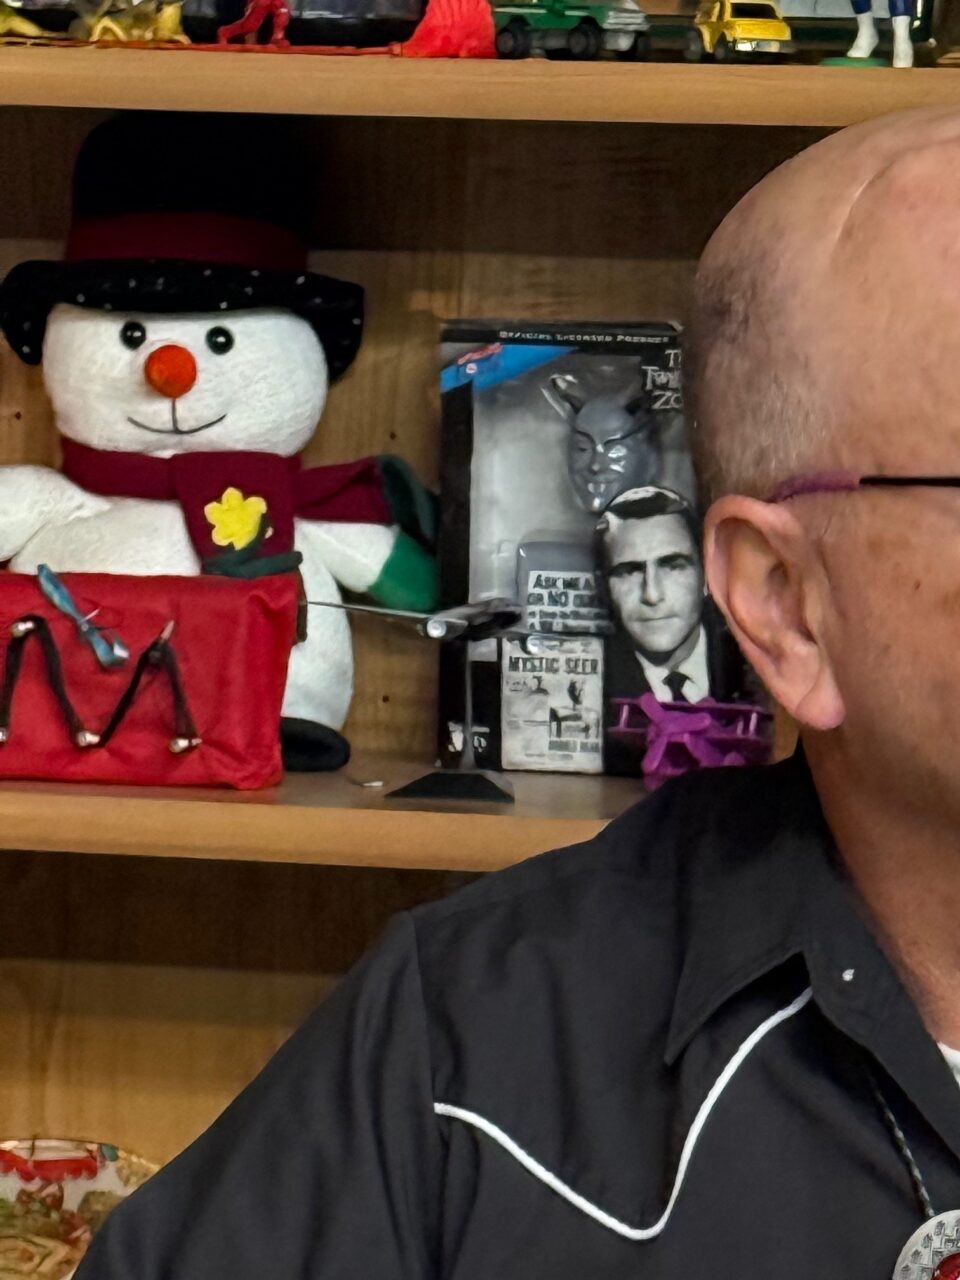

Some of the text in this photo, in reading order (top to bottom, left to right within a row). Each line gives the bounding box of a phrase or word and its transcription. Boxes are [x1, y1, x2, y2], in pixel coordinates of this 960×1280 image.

[547, 590, 569, 608] NO
[508, 656, 599, 676] MYSTIC SEER
